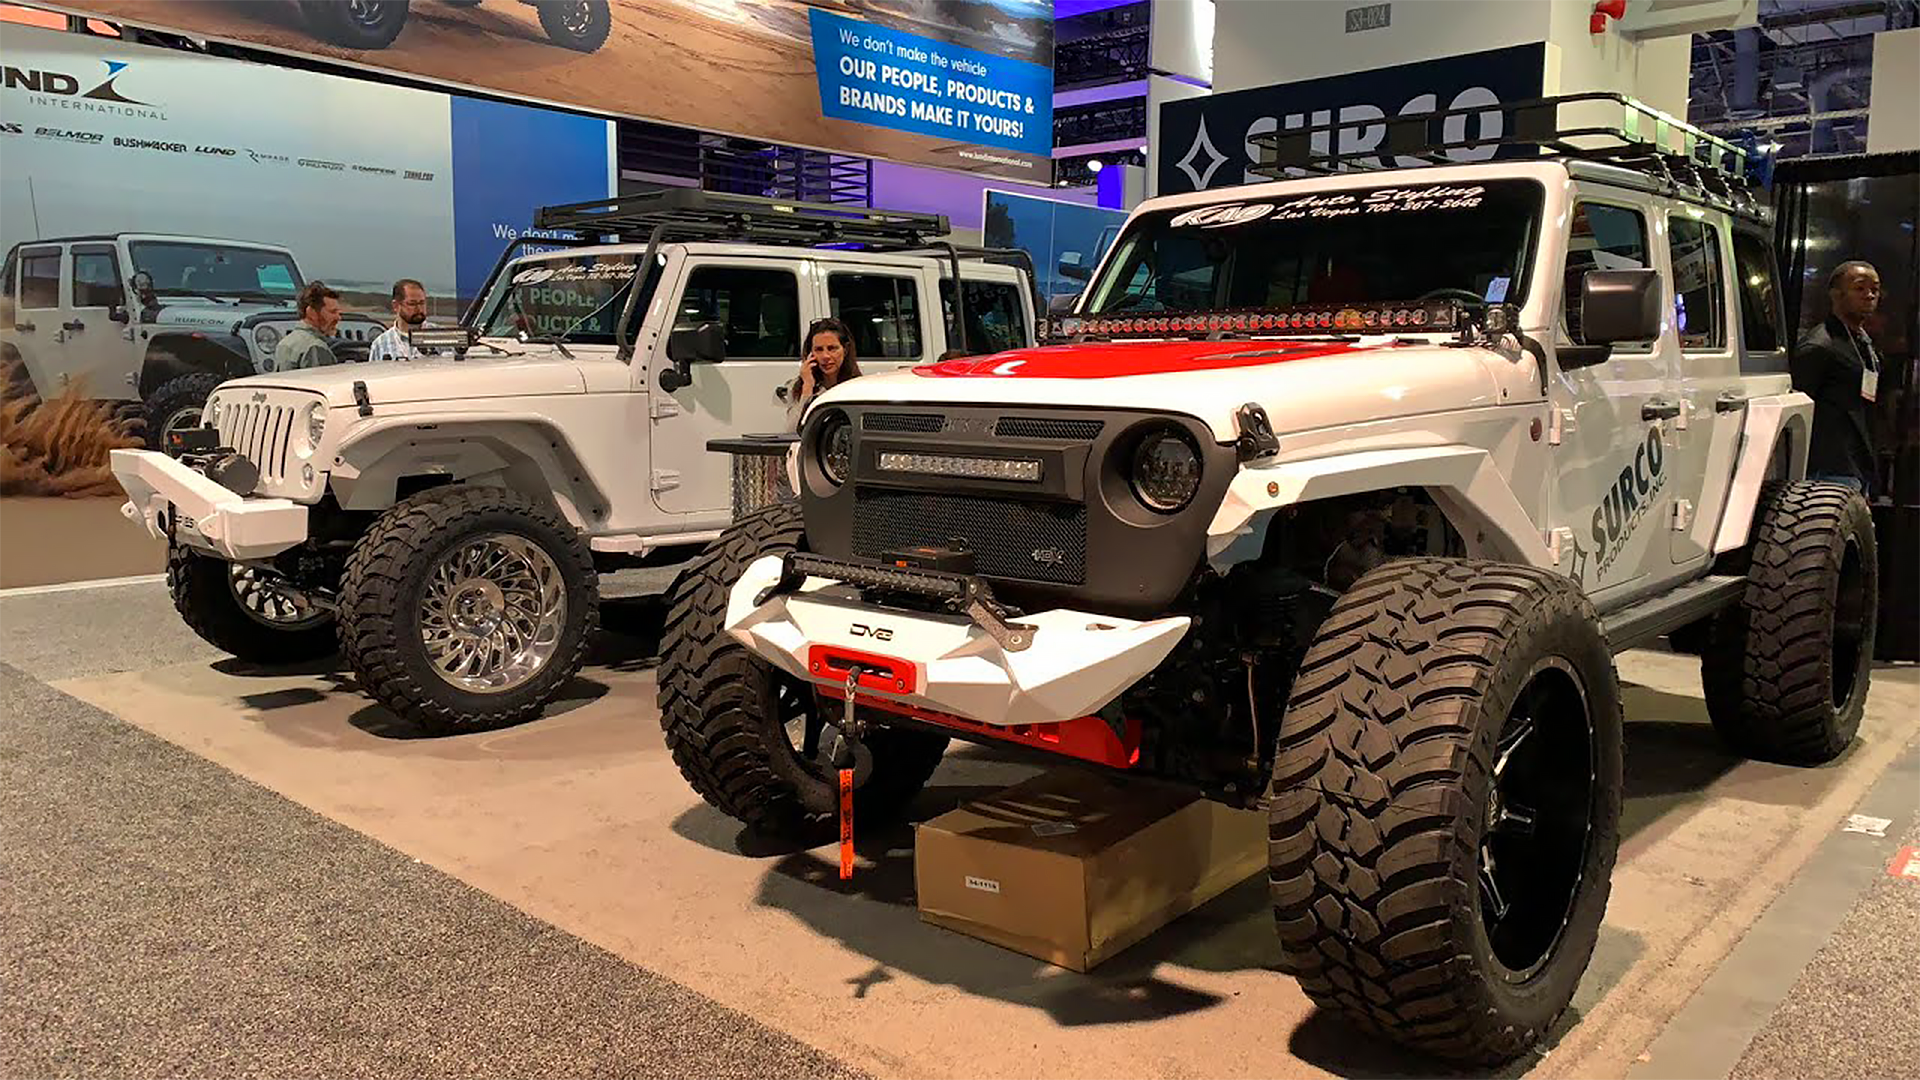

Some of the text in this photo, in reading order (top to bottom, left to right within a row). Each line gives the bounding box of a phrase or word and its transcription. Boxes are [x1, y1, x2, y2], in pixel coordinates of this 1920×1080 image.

[839, 28, 987, 77] We don't make the vehicle
[0, 66, 79, 95] ND
[839, 56, 1035, 114] OUR PEOPLE, PRODUCTS &
[30, 96, 168, 120] INTERNATIONAL
[839, 85, 1024, 139] BRANDS MAKE IT YOURS!
[35, 127, 104, 141] BELMOR
[113, 137, 187, 153] BUSHWACKER
[195, 145, 236, 157] LUND
[1277, 195, 1356, 210] Auto
[1362, 186, 1485, 203] Styling
[1270, 210, 1306, 221] Las
[1309, 207, 1359, 219] Vegas
[492, 223, 517, 239] We
[175, 316, 225, 325] RUBICON
[1592, 426, 1663, 565] SURCO
